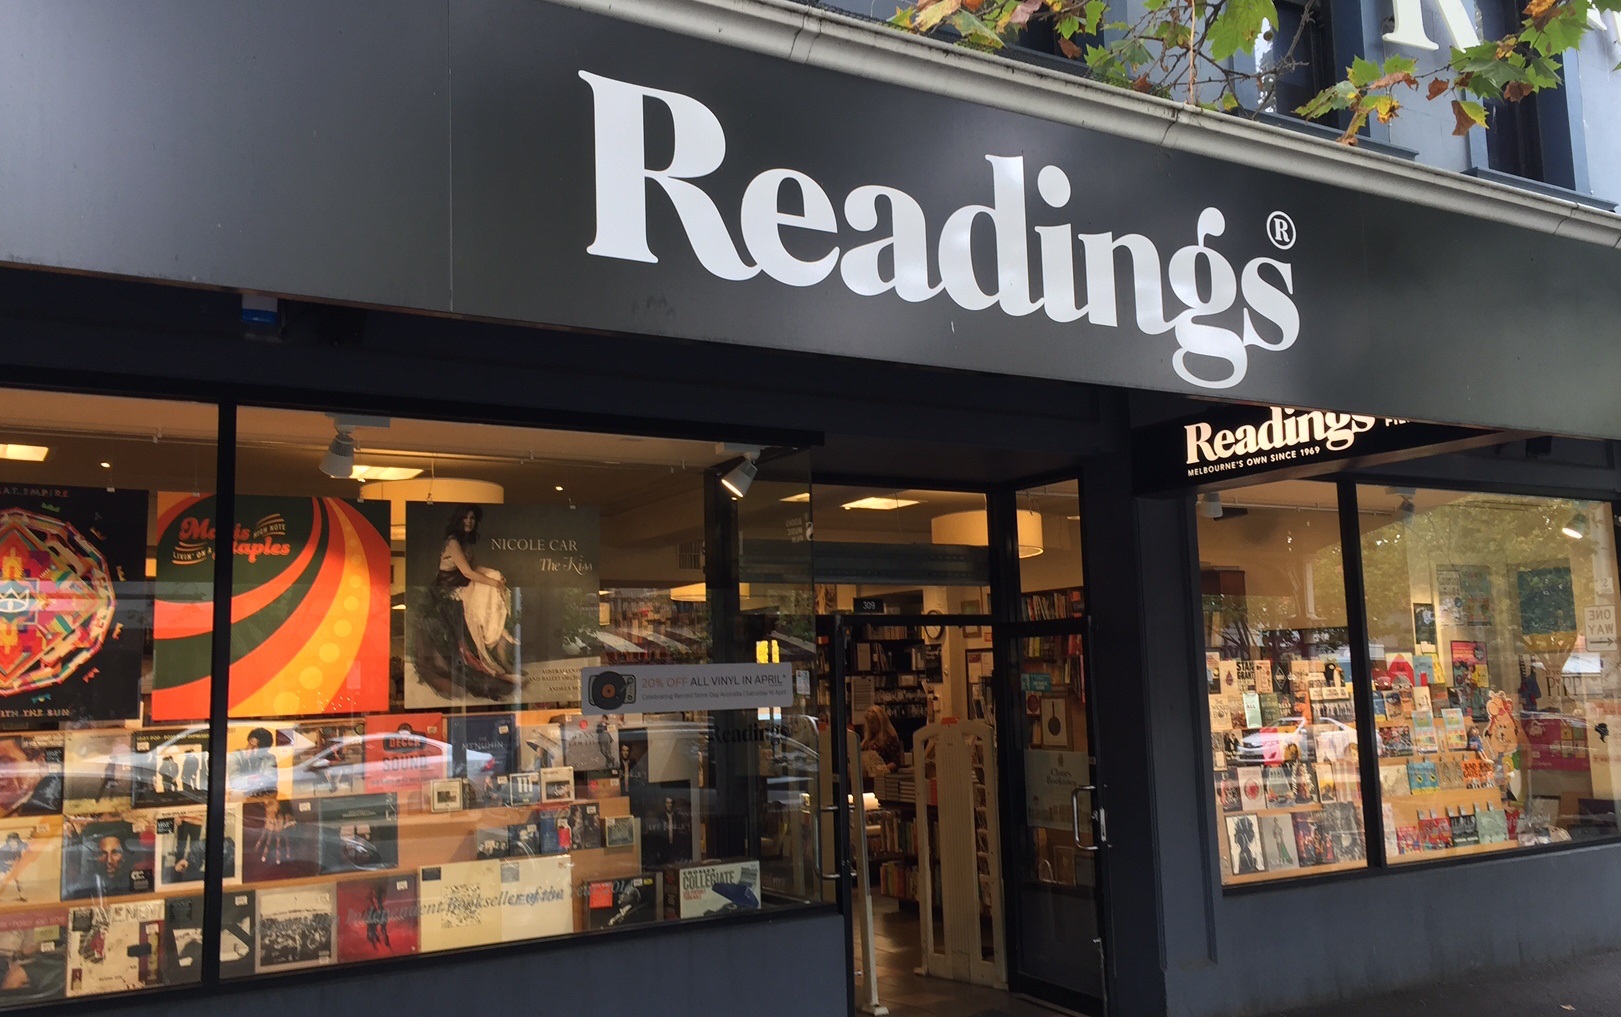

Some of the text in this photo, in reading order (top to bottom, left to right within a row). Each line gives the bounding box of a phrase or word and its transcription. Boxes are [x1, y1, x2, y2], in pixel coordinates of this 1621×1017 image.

[578, 70, 1301, 390] Readings
[1184, 406, 1376, 465] Readings
[1187, 446, 1320, 477] MELBOURNE'S OWN SINCE 1969
[23, 487, 69, 498] EMPIRE
[269, 523, 286, 532] NOTE
[491, 538, 579, 552] NICOLE CAR
[540, 555, 594, 576] The Kiss
[862, 601, 876, 610] 309
[1236, 661, 1254, 671] STAN
[642, 678, 664, 689] 20%
[667, 677, 688, 688] OFF
[690, 676, 709, 687] ALL
[711, 675, 740, 686] VINYL
[742, 675, 752, 684] IN
[47, 708, 70, 717] SUN
[389, 737, 421, 748] DECCA
[383, 755, 429, 771] SOUND
[682, 870, 736, 891] COLLEGIATE
